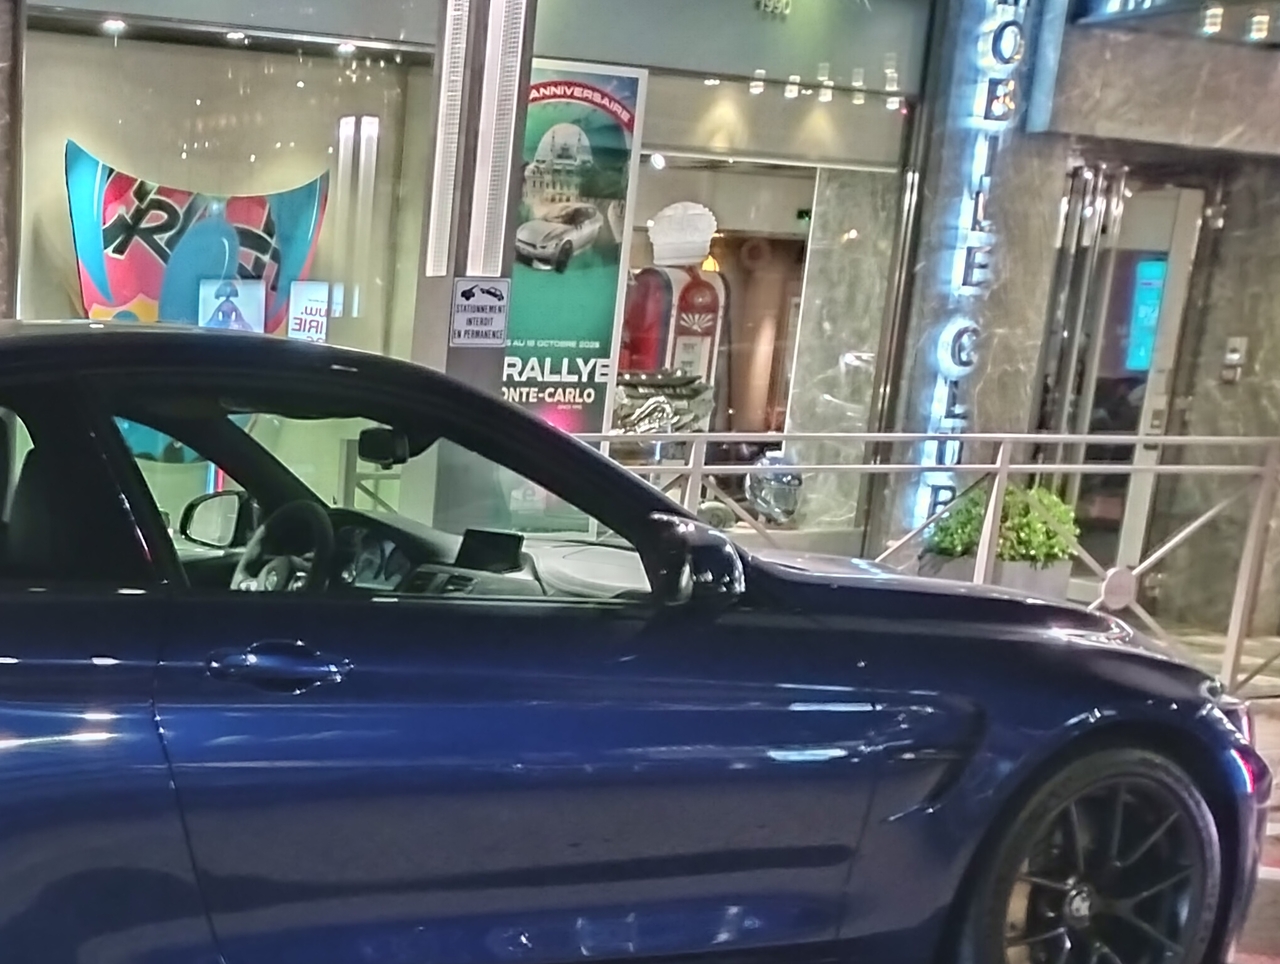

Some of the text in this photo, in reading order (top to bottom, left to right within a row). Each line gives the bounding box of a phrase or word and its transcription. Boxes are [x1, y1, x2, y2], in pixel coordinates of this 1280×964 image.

[529, 84, 631, 123] ANNIVERSAIRE
[927, 0, 1024, 520] OBILE CLUB
[456, 304, 506, 314] STATIONNEMENT
[465, 316, 494, 326] INTERDIT
[453, 329, 503, 339] EN PERMANENCE
[537, 340, 577, 348] OCTOBRE
[503, 356, 612, 382] RALLYE
[502, 387, 595, 403] ONTE-CARLO
